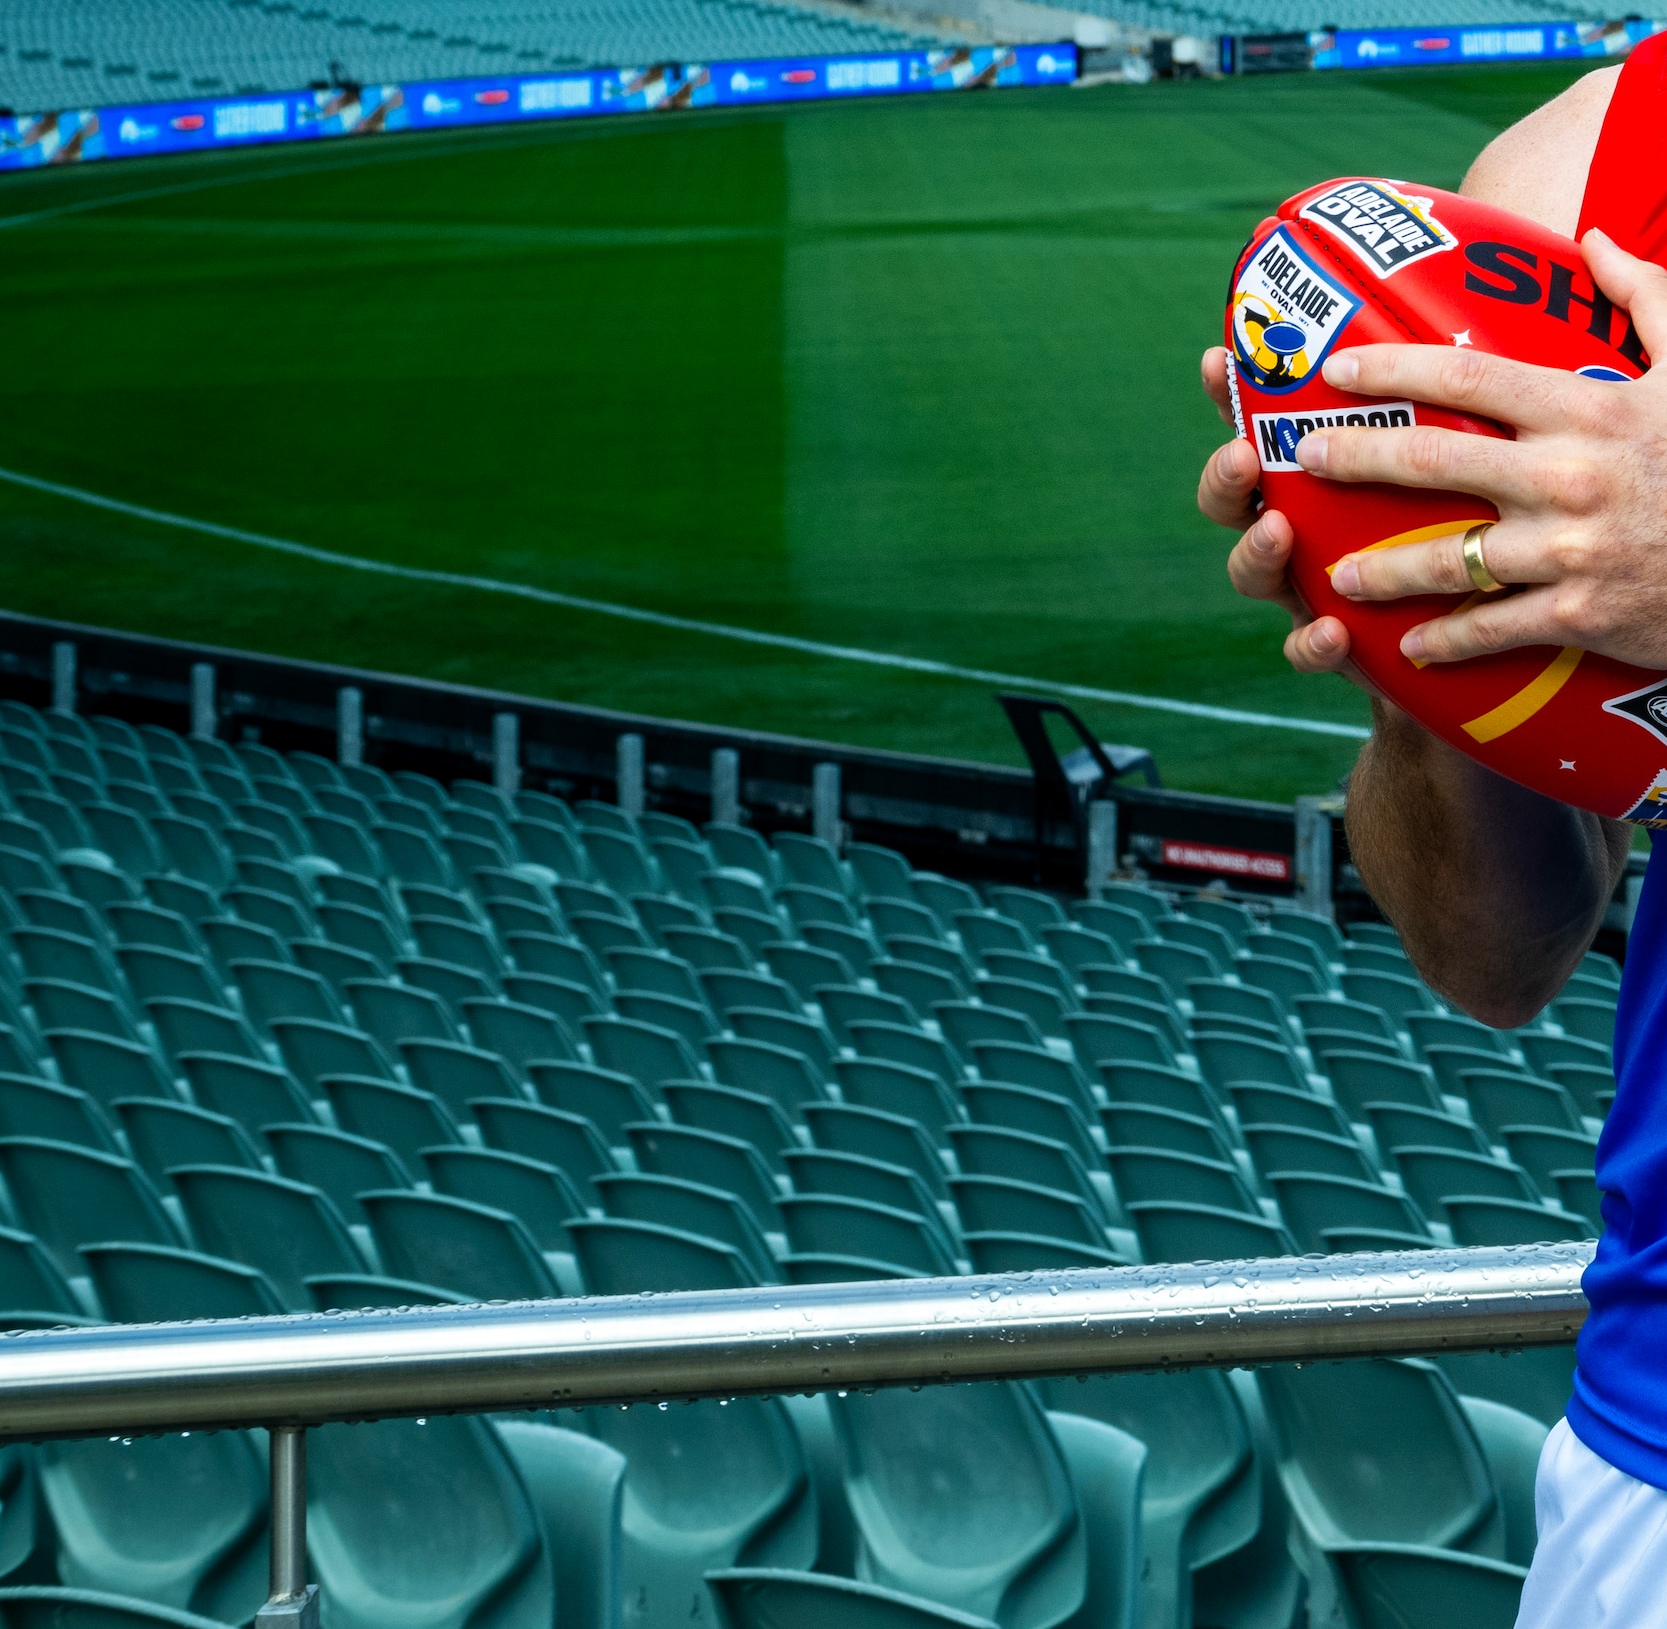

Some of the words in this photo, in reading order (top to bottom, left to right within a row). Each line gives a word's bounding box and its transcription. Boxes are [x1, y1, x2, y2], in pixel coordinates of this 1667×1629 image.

[1316, 197, 1399, 264] OVAL
[1337, 186, 1434, 253] ADELAIDE
[1258, 243, 1340, 328] ADELAIDE
[1270, 288, 1294, 317] OVAL
